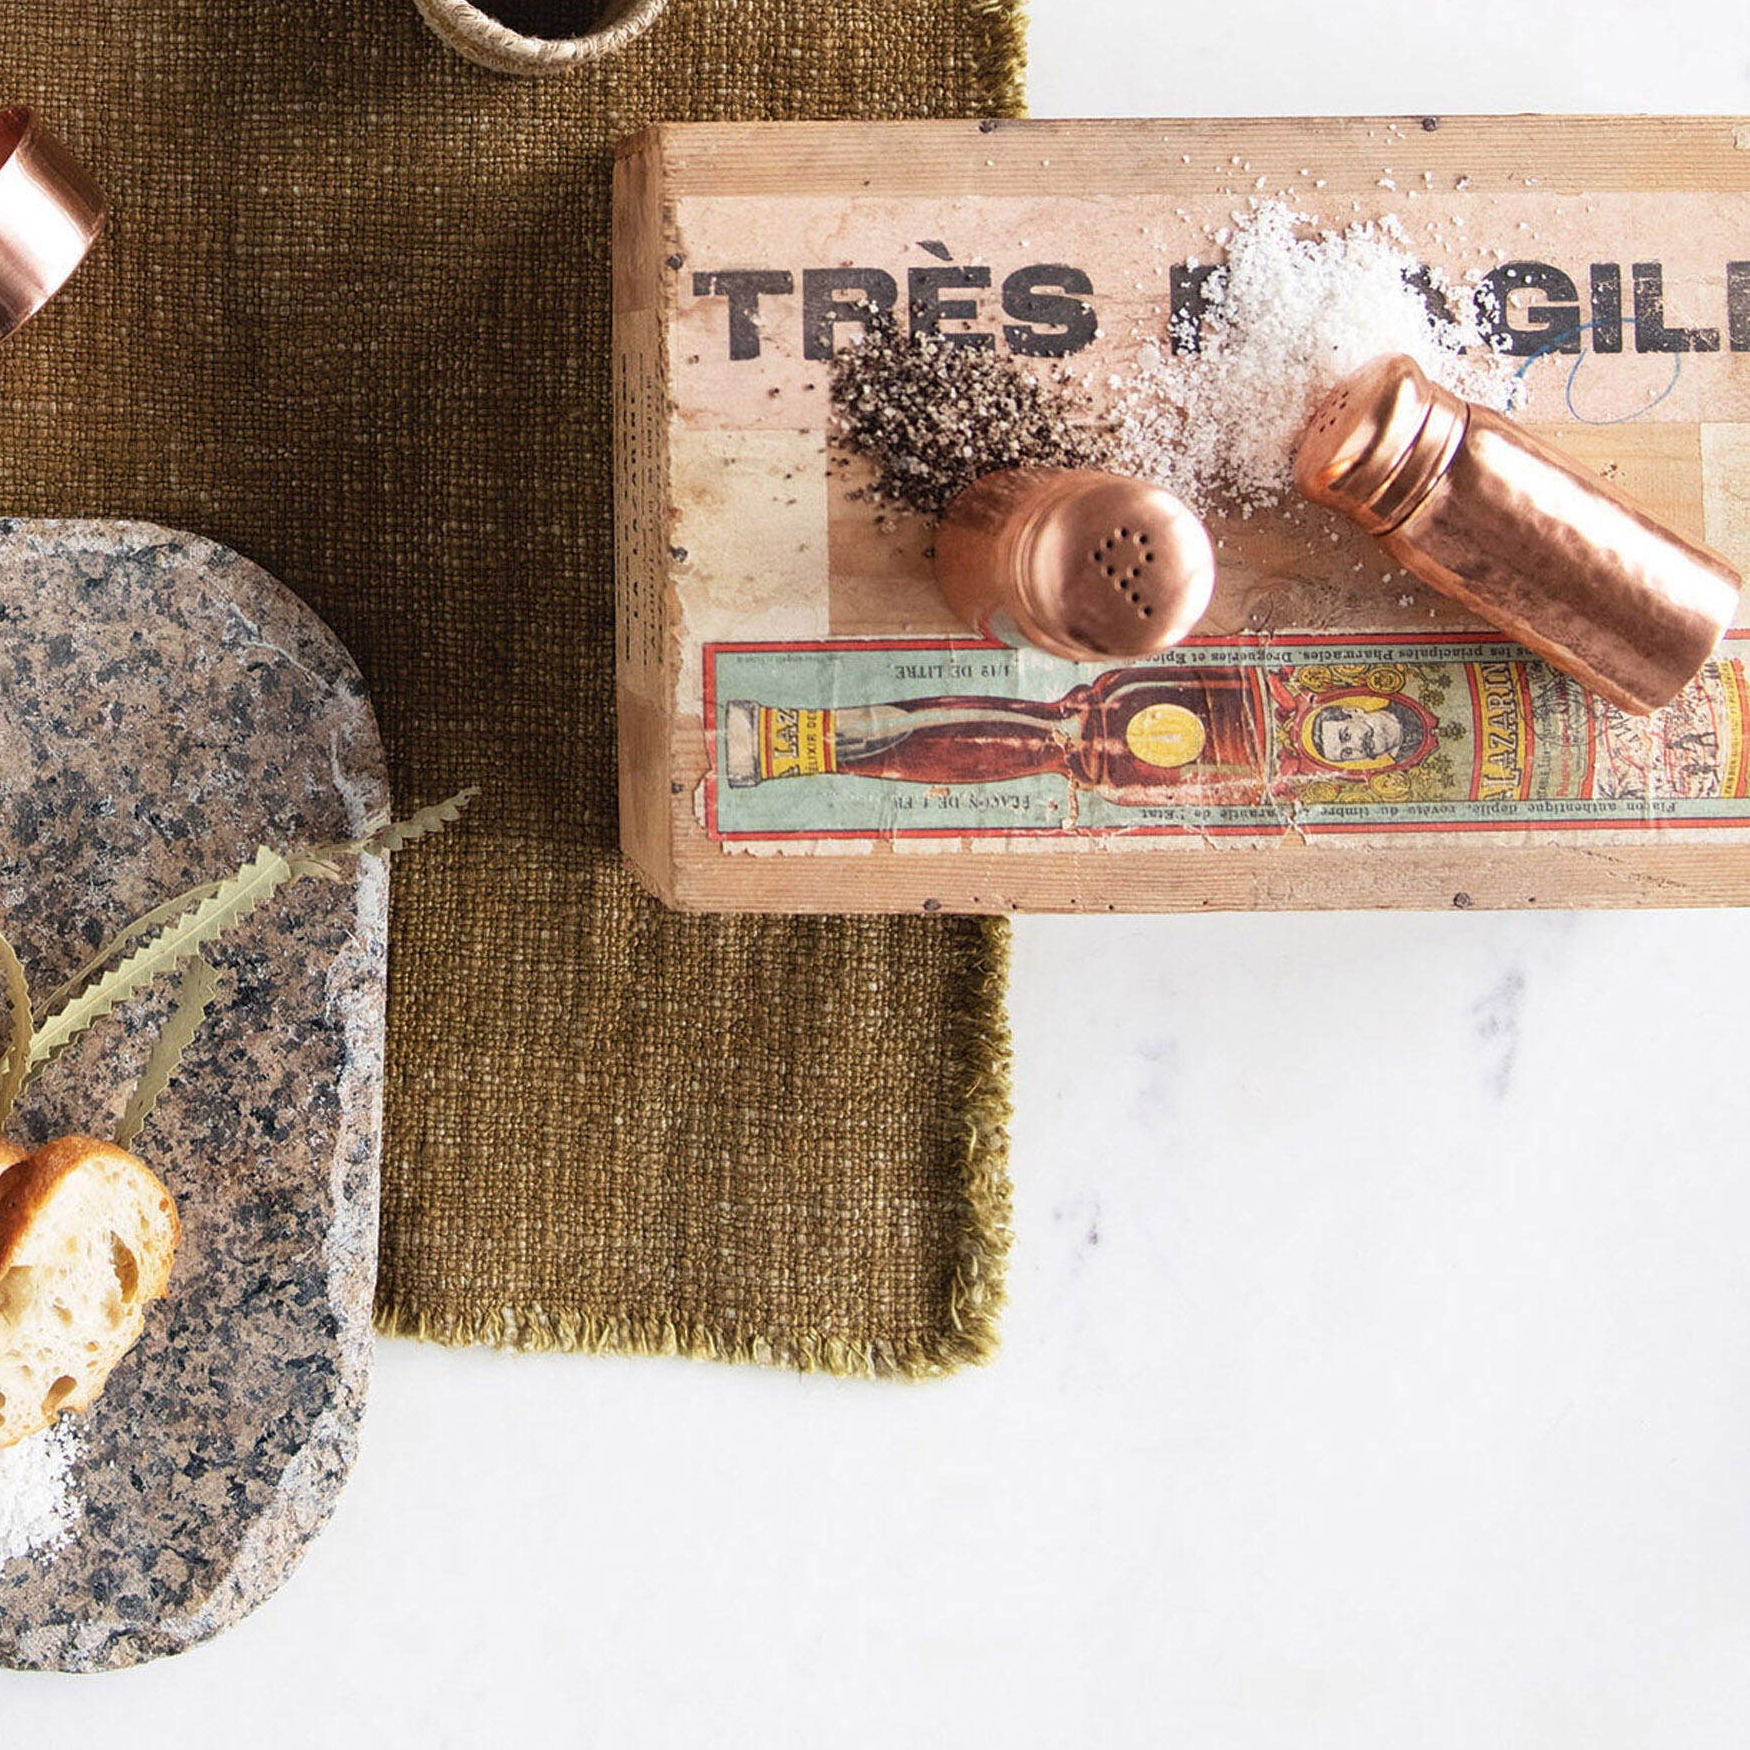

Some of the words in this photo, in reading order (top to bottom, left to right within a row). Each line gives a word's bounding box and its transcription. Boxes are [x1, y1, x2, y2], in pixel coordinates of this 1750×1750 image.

[692, 239, 1099, 361] TRÈS
[1188, 653, 1208, 663] et
[1210, 648, 1293, 662] Drogueries
[1397, 645, 1486, 661] principales
[1490, 646, 1512, 658] les
[950, 665, 973, 679] DE
[1319, 806, 1371, 818] timbre
[1527, 801, 1618, 815] authentique
